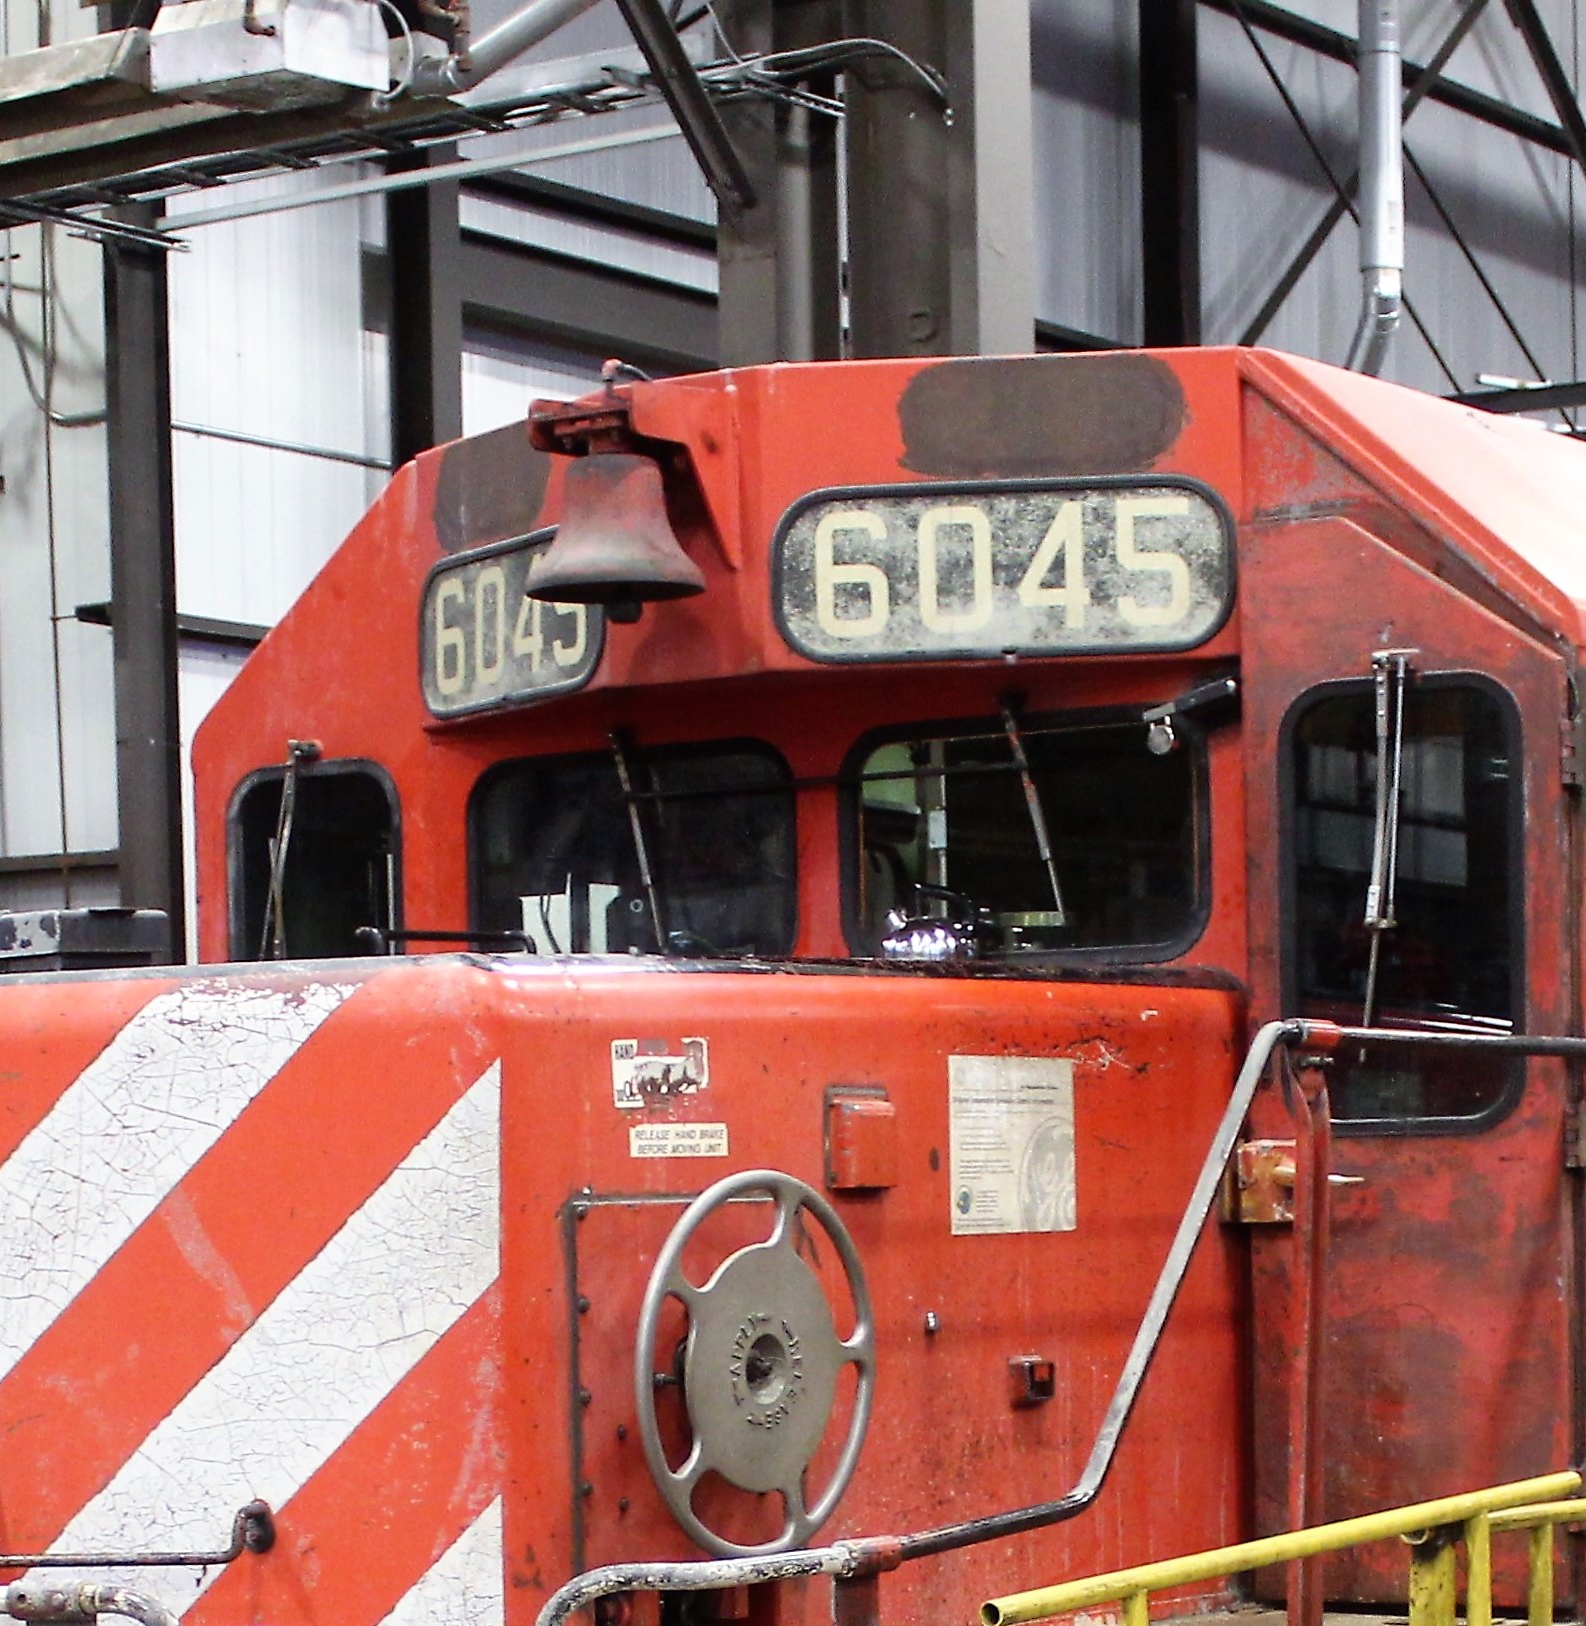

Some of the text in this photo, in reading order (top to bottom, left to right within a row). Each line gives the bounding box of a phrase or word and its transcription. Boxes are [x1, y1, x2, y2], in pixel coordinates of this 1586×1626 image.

[814, 497, 1191, 639] 6045
[435, 553, 587, 695] 6045
[634, 1128, 725, 1141] RELEASE HAND BRAKE
[637, 1143, 722, 1155] BEFORE MOVING UNIT
